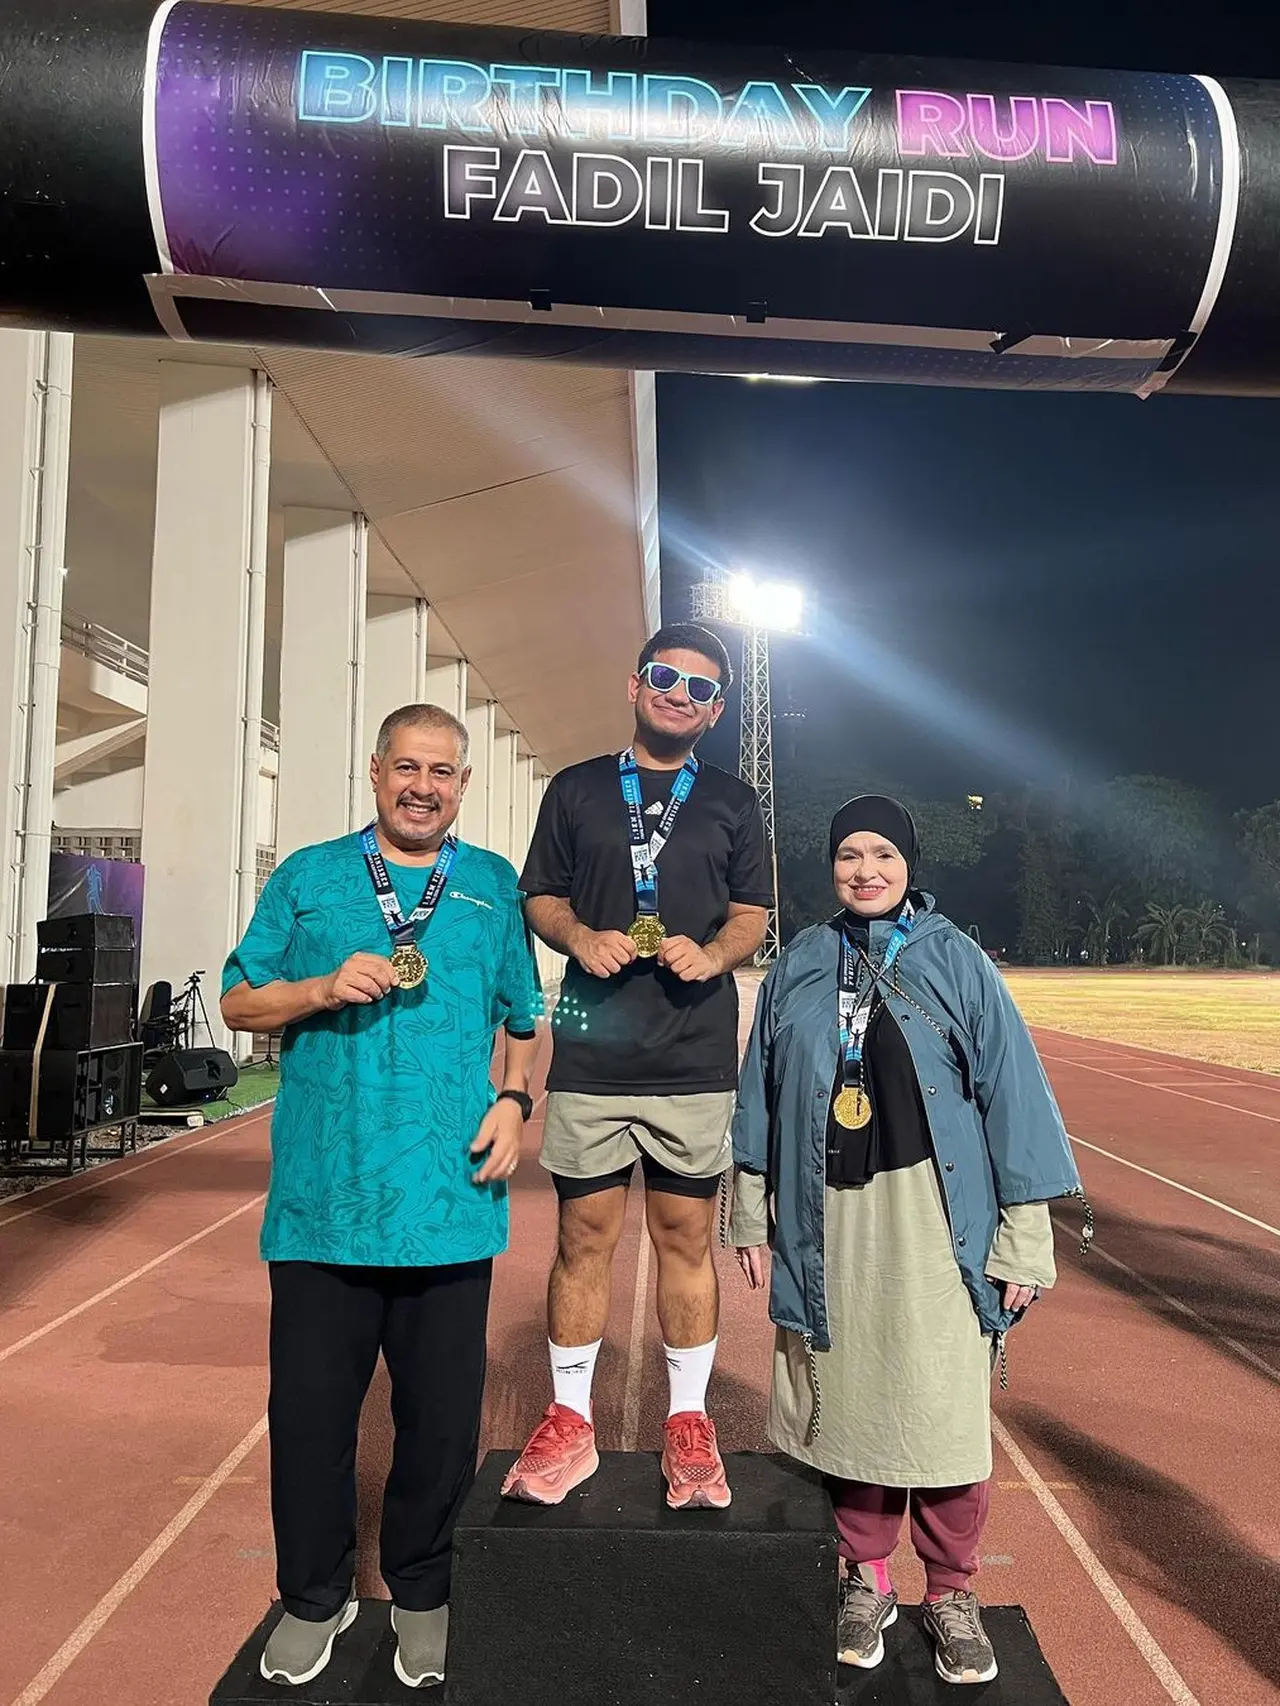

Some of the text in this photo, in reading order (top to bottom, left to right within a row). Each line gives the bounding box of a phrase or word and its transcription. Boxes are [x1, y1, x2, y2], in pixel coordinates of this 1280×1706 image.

[298, 50, 1118, 165] BIRTHDAY RUN
[443, 145, 1005, 246] FADIL JAIDI
